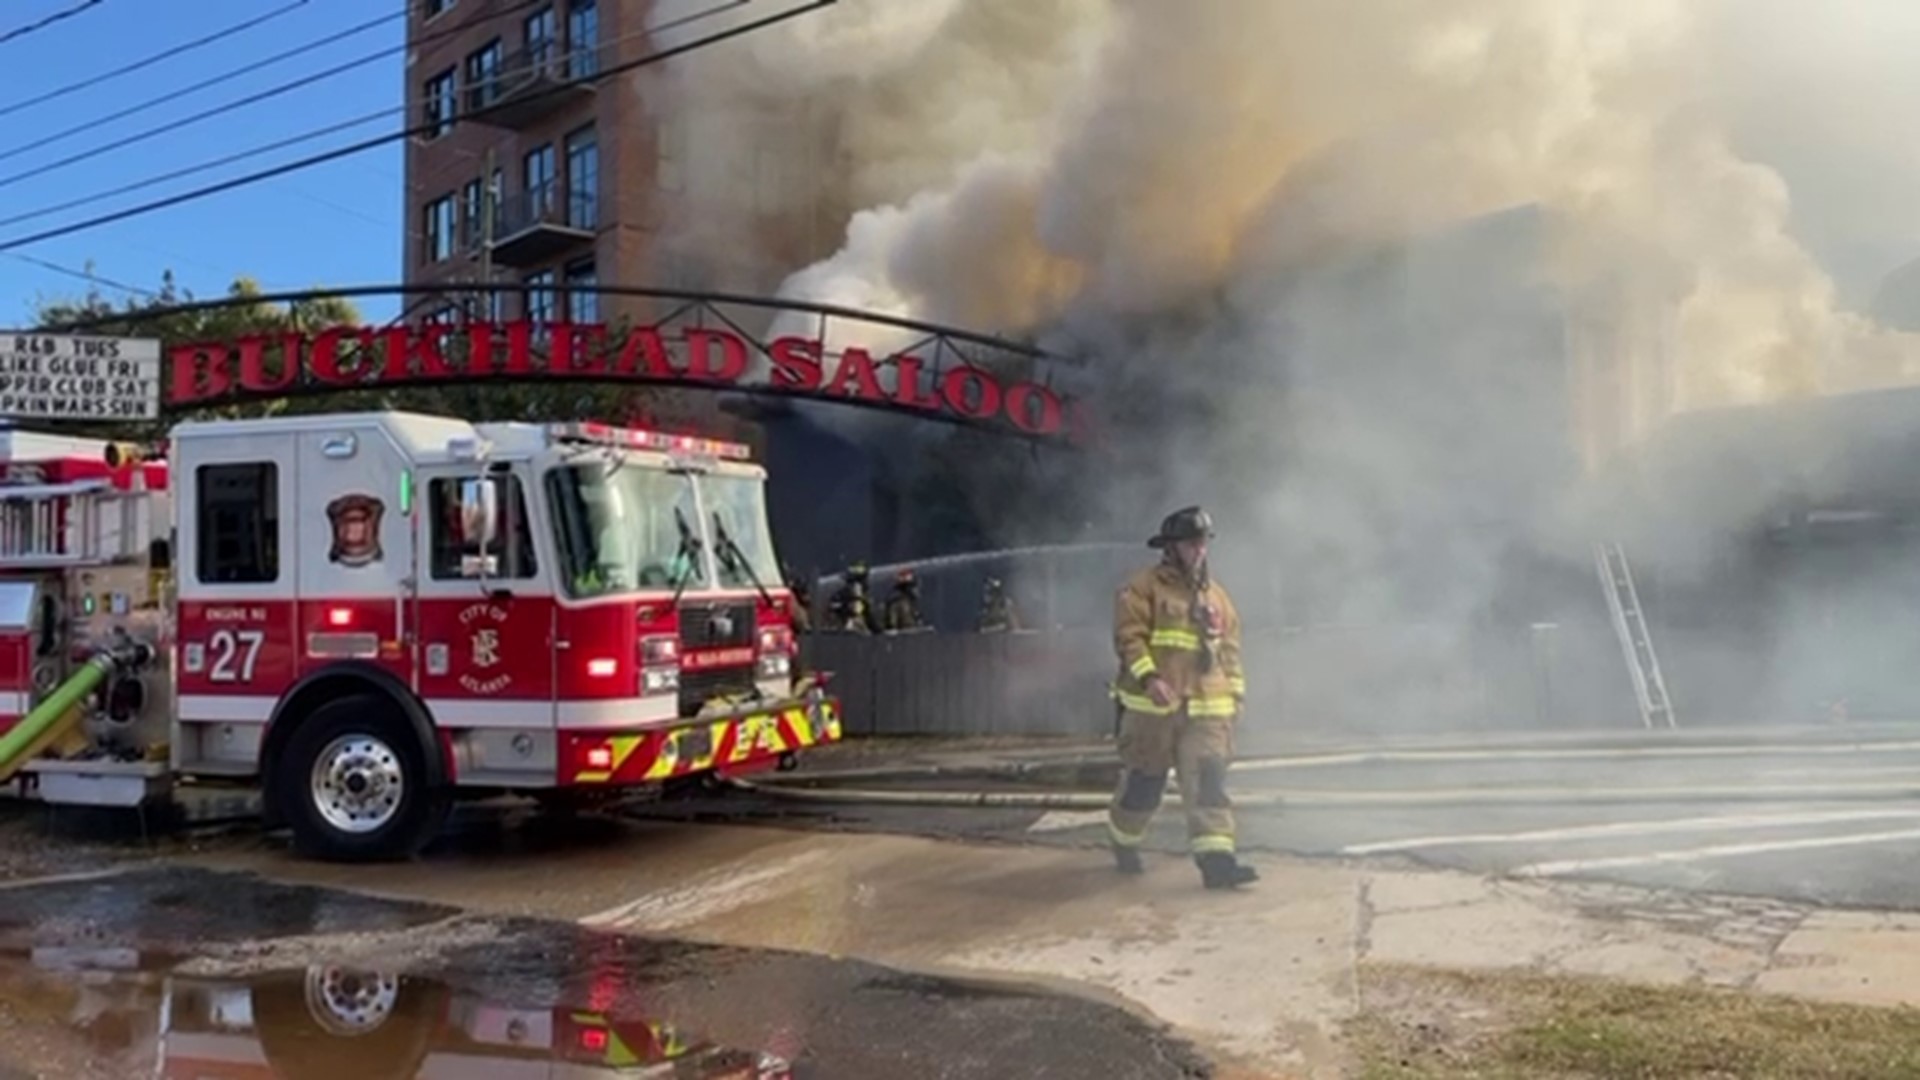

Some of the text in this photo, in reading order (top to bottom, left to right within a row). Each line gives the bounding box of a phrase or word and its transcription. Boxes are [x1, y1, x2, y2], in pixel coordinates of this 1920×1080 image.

[72, 339, 121, 357] TUES
[50, 357, 99, 376] GLUE
[107, 360, 139, 377] FRI
[56, 378, 106, 396] CLUB
[112, 380, 148, 397] SAT
[167, 319, 1106, 443] BUCKHEAD SALOO
[109, 398, 147, 415] SUN
[209, 629, 264, 683] 27
[459, 673, 512, 694] ATLANTA
